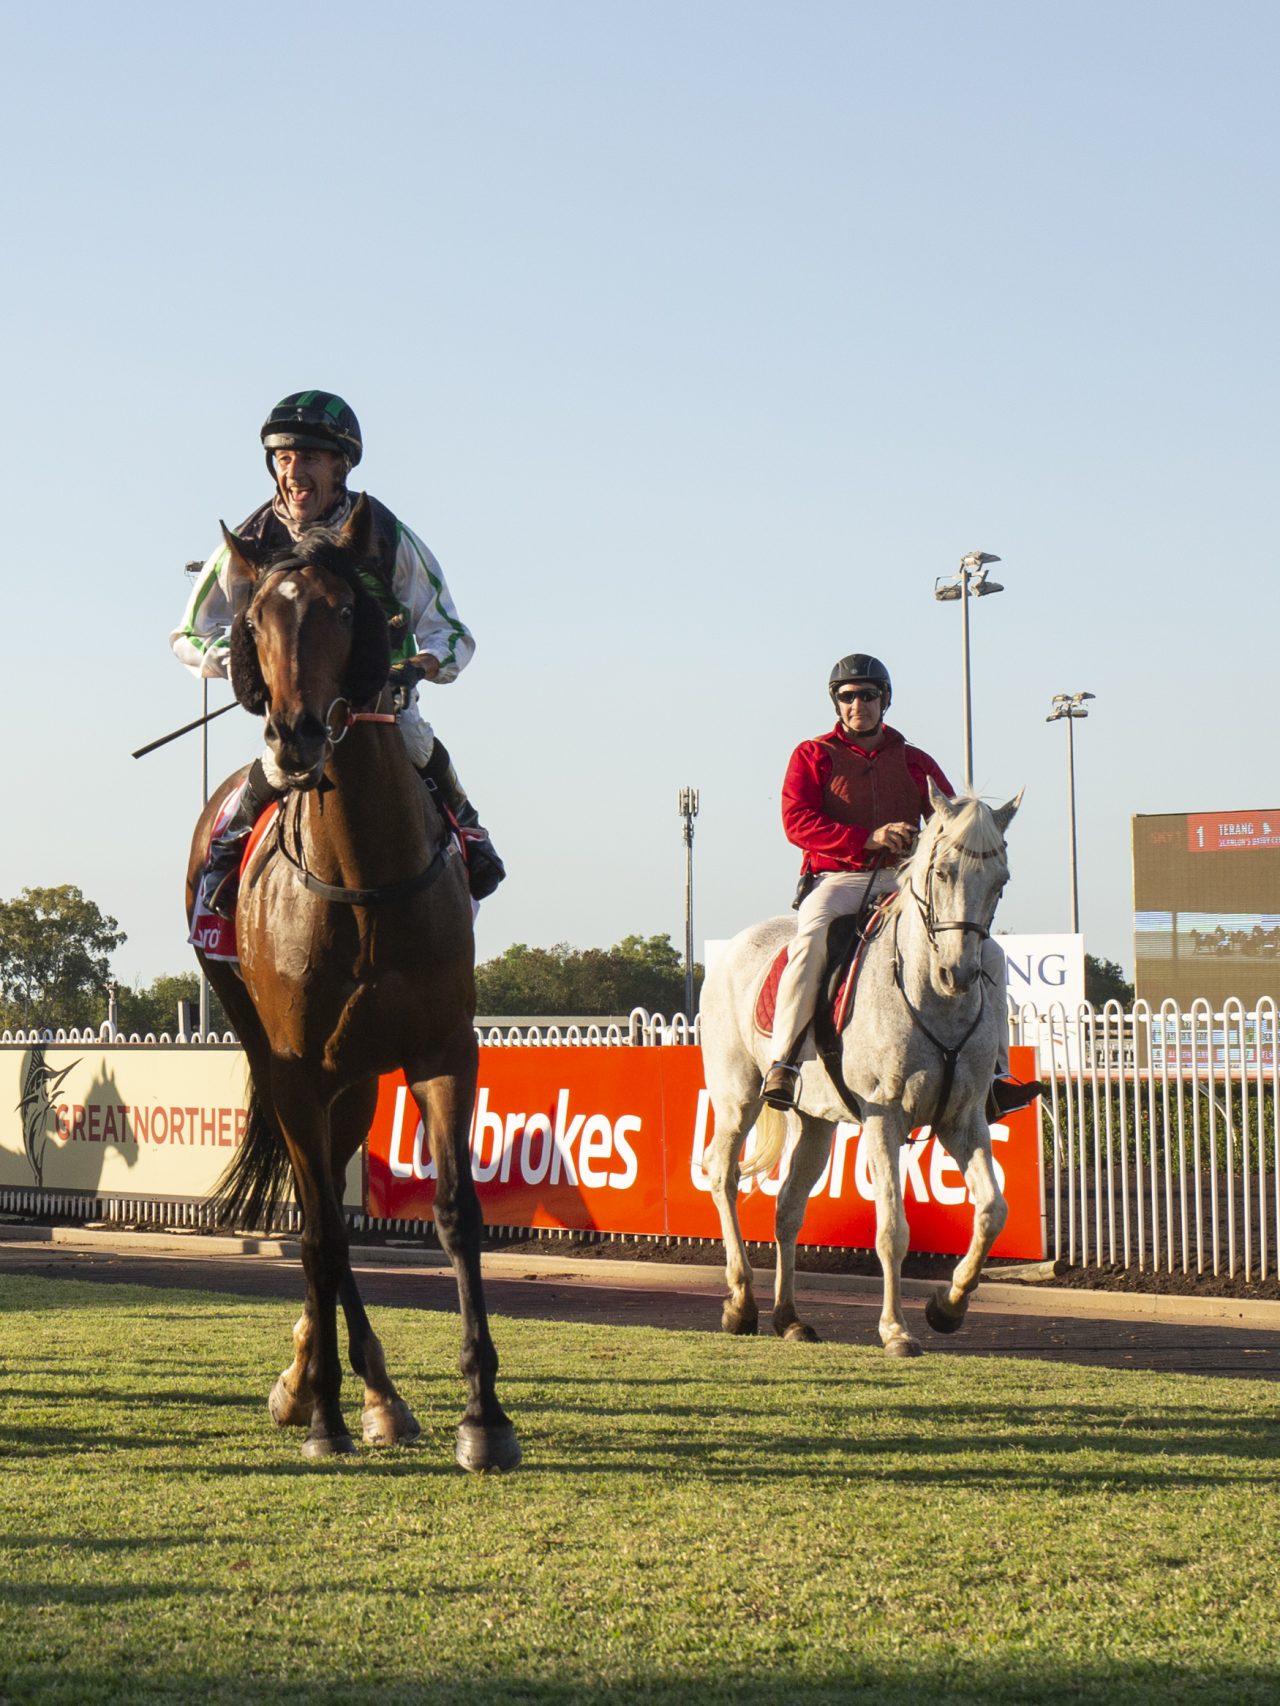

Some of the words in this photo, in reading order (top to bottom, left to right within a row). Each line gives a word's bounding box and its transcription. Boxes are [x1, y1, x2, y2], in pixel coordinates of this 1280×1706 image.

[55, 1103, 131, 1143] GREAT
[133, 1105, 250, 1148] NORTHER
[389, 1086, 642, 1190] Labrokes
